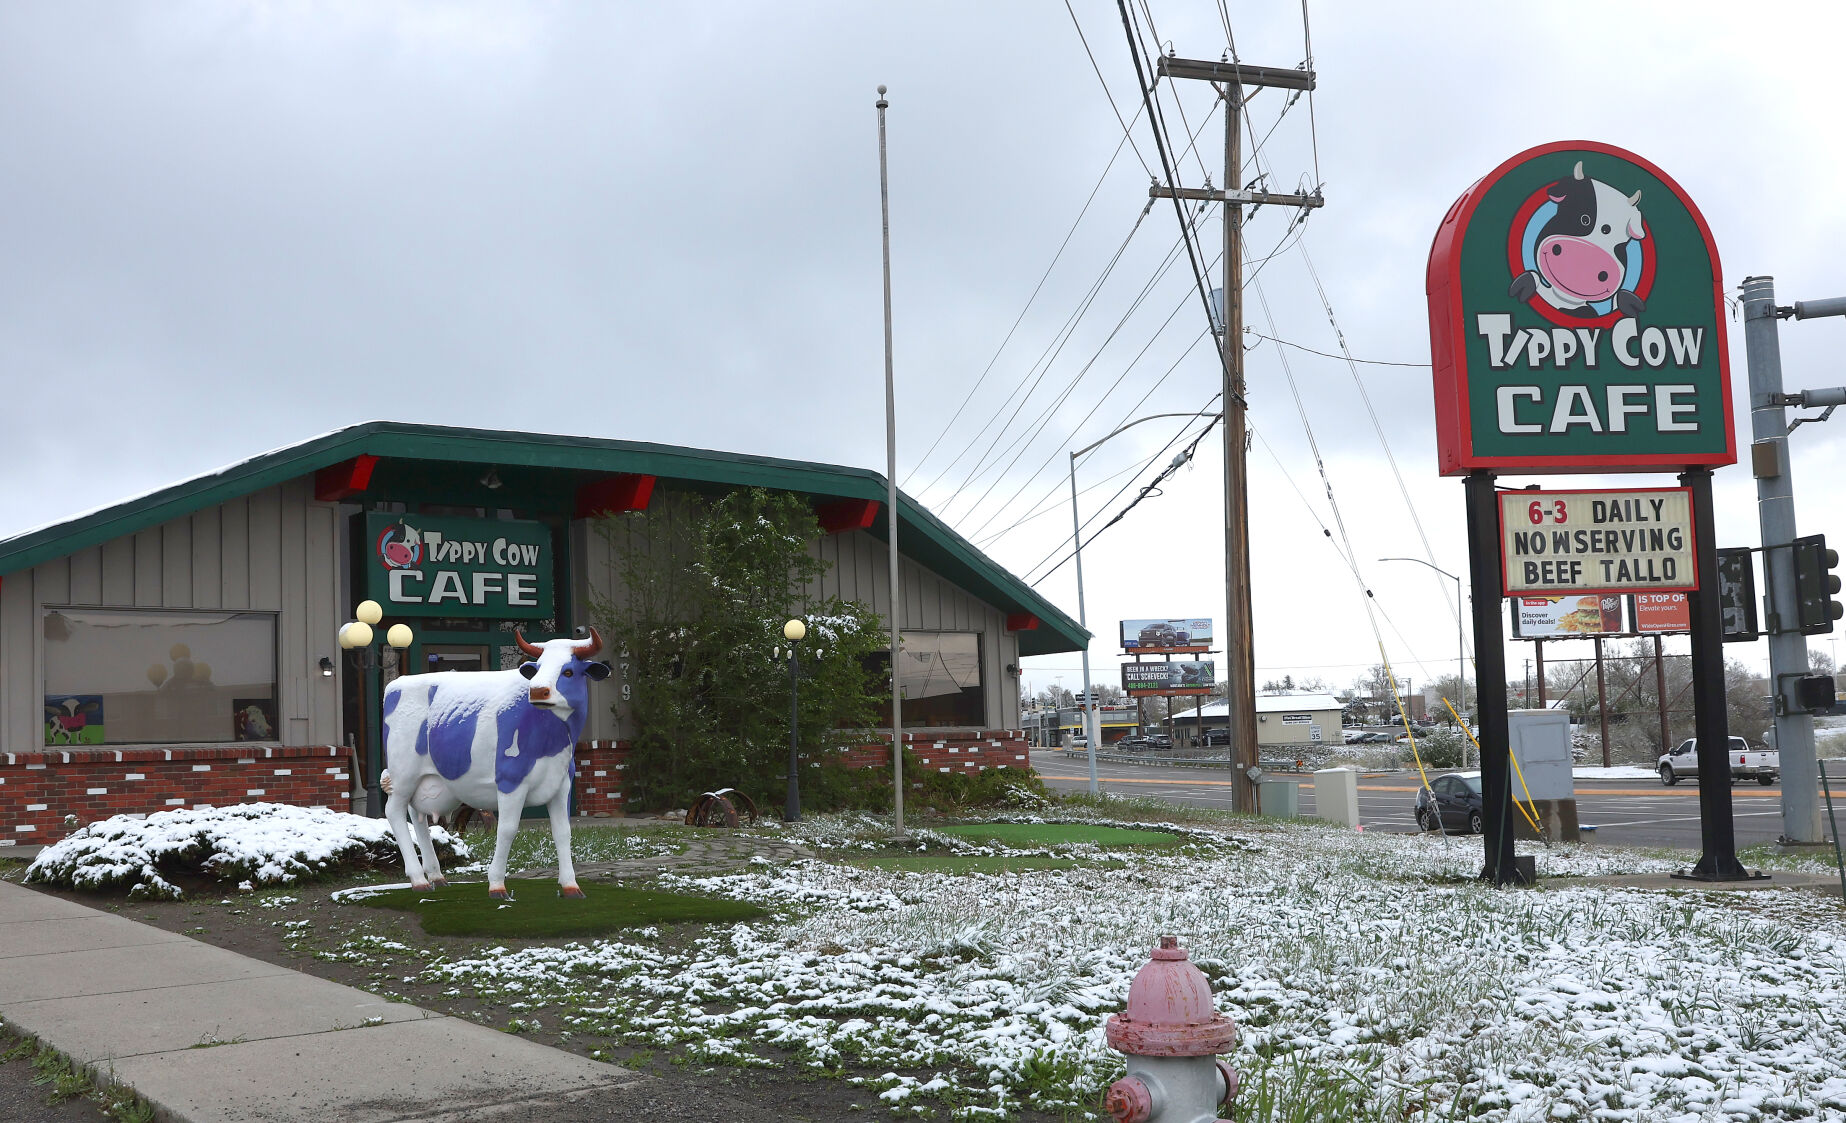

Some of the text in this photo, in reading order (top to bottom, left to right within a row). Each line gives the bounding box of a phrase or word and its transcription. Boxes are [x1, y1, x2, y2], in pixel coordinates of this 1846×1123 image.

[1496, 385, 1699, 433] CAFE
[1528, 498, 1664, 525] 6-3 DAILY
[1524, 557, 1676, 585] BEEF TALLO
[389, 569, 537, 606] CAFE
[1638, 593, 1685, 604] IS TOP OF
[1127, 673, 1140, 681] CALL
